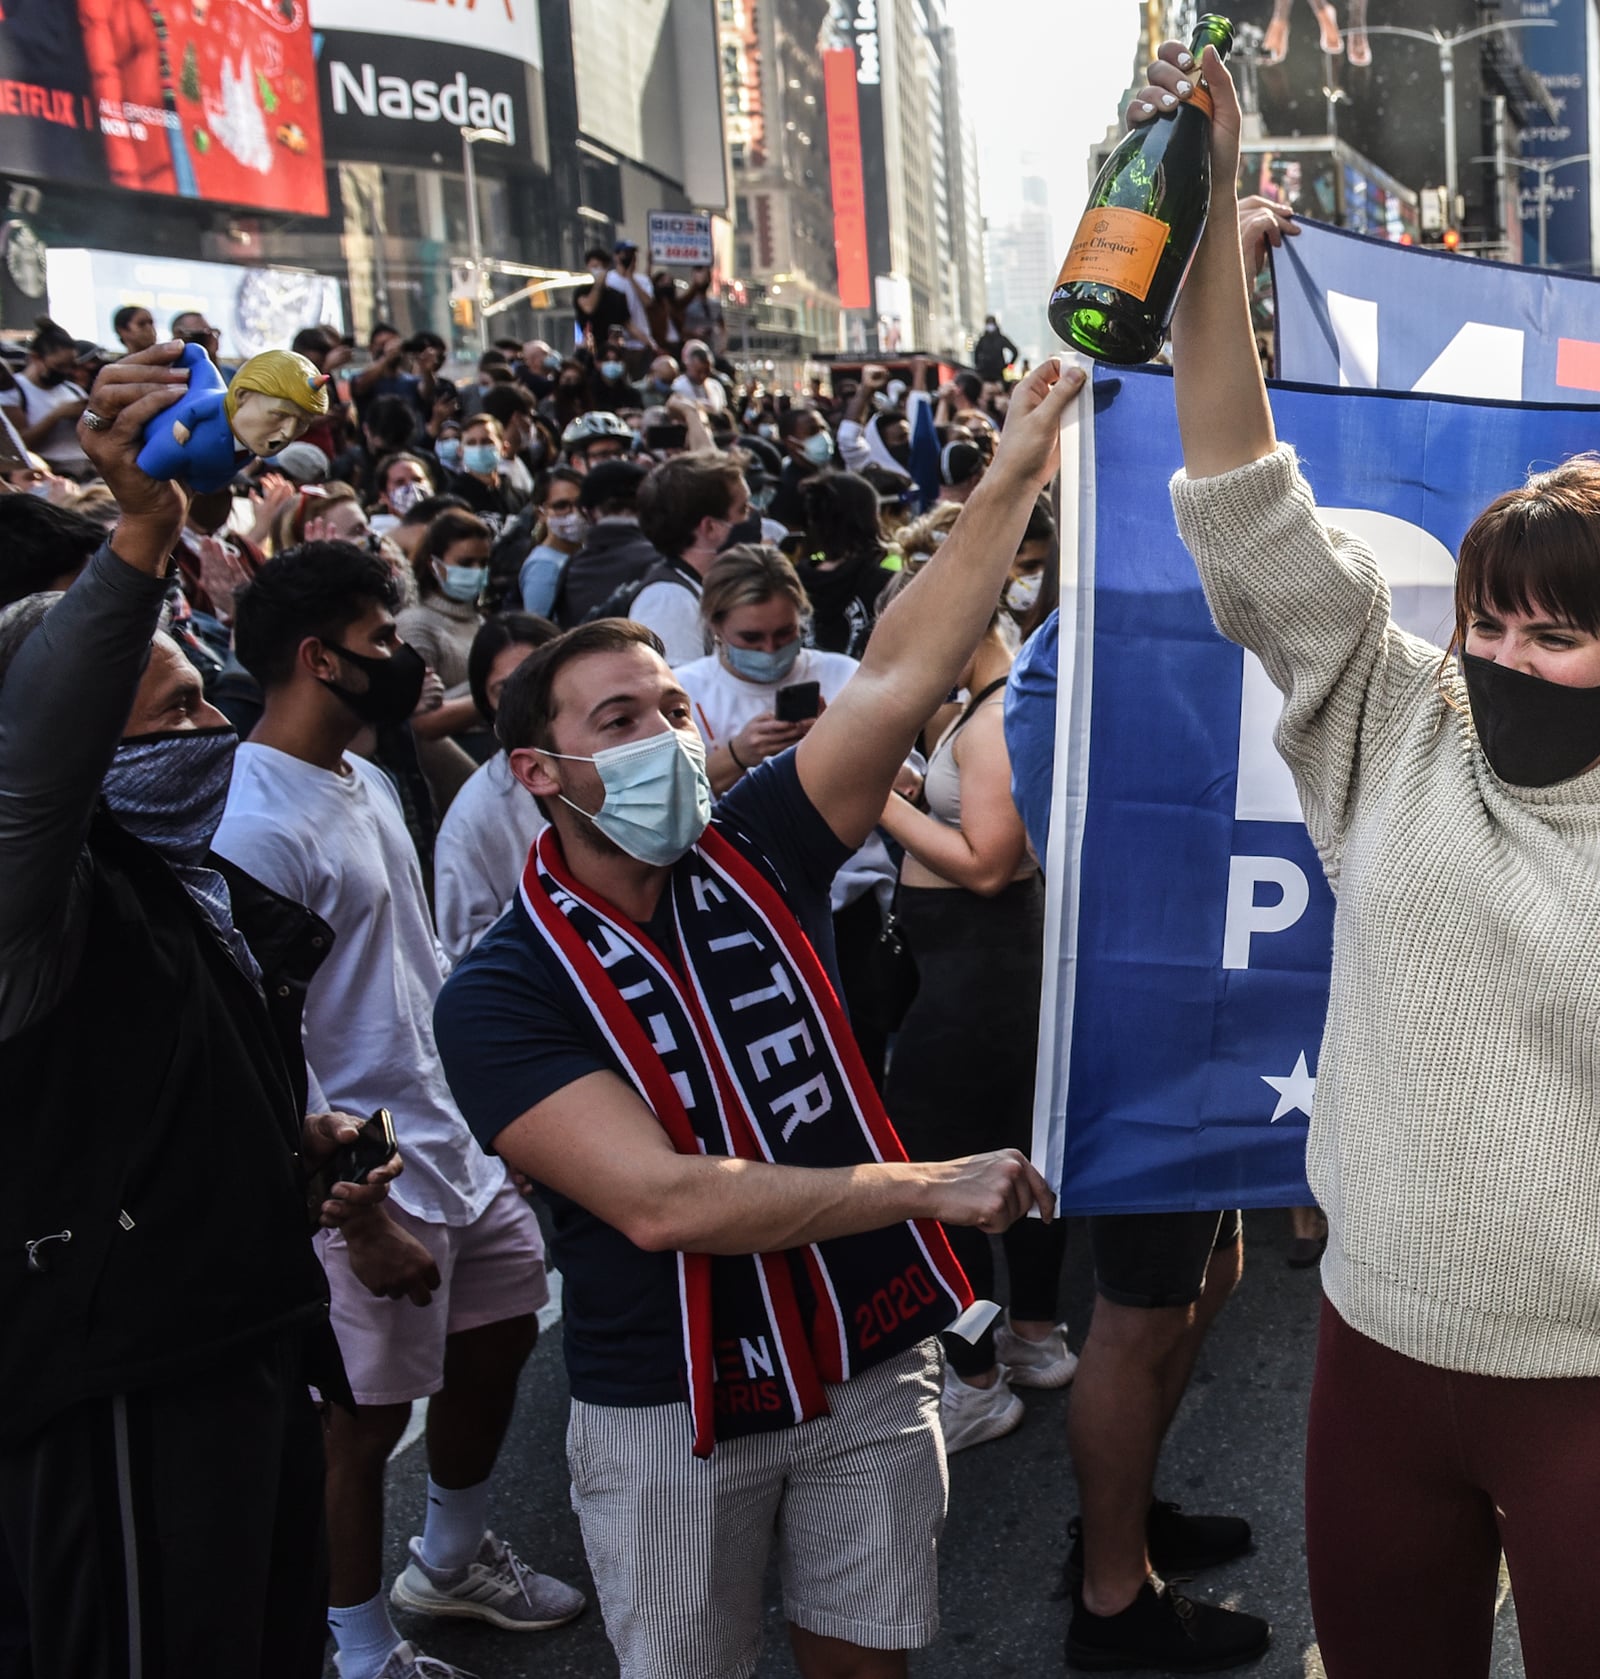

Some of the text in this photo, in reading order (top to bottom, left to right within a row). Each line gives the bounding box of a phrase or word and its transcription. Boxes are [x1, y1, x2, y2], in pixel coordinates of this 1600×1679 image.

[330, 61, 515, 146] Nasdaq
[1090, 237, 1137, 255] Clicquot
[855, 1264, 937, 1350] 2020
